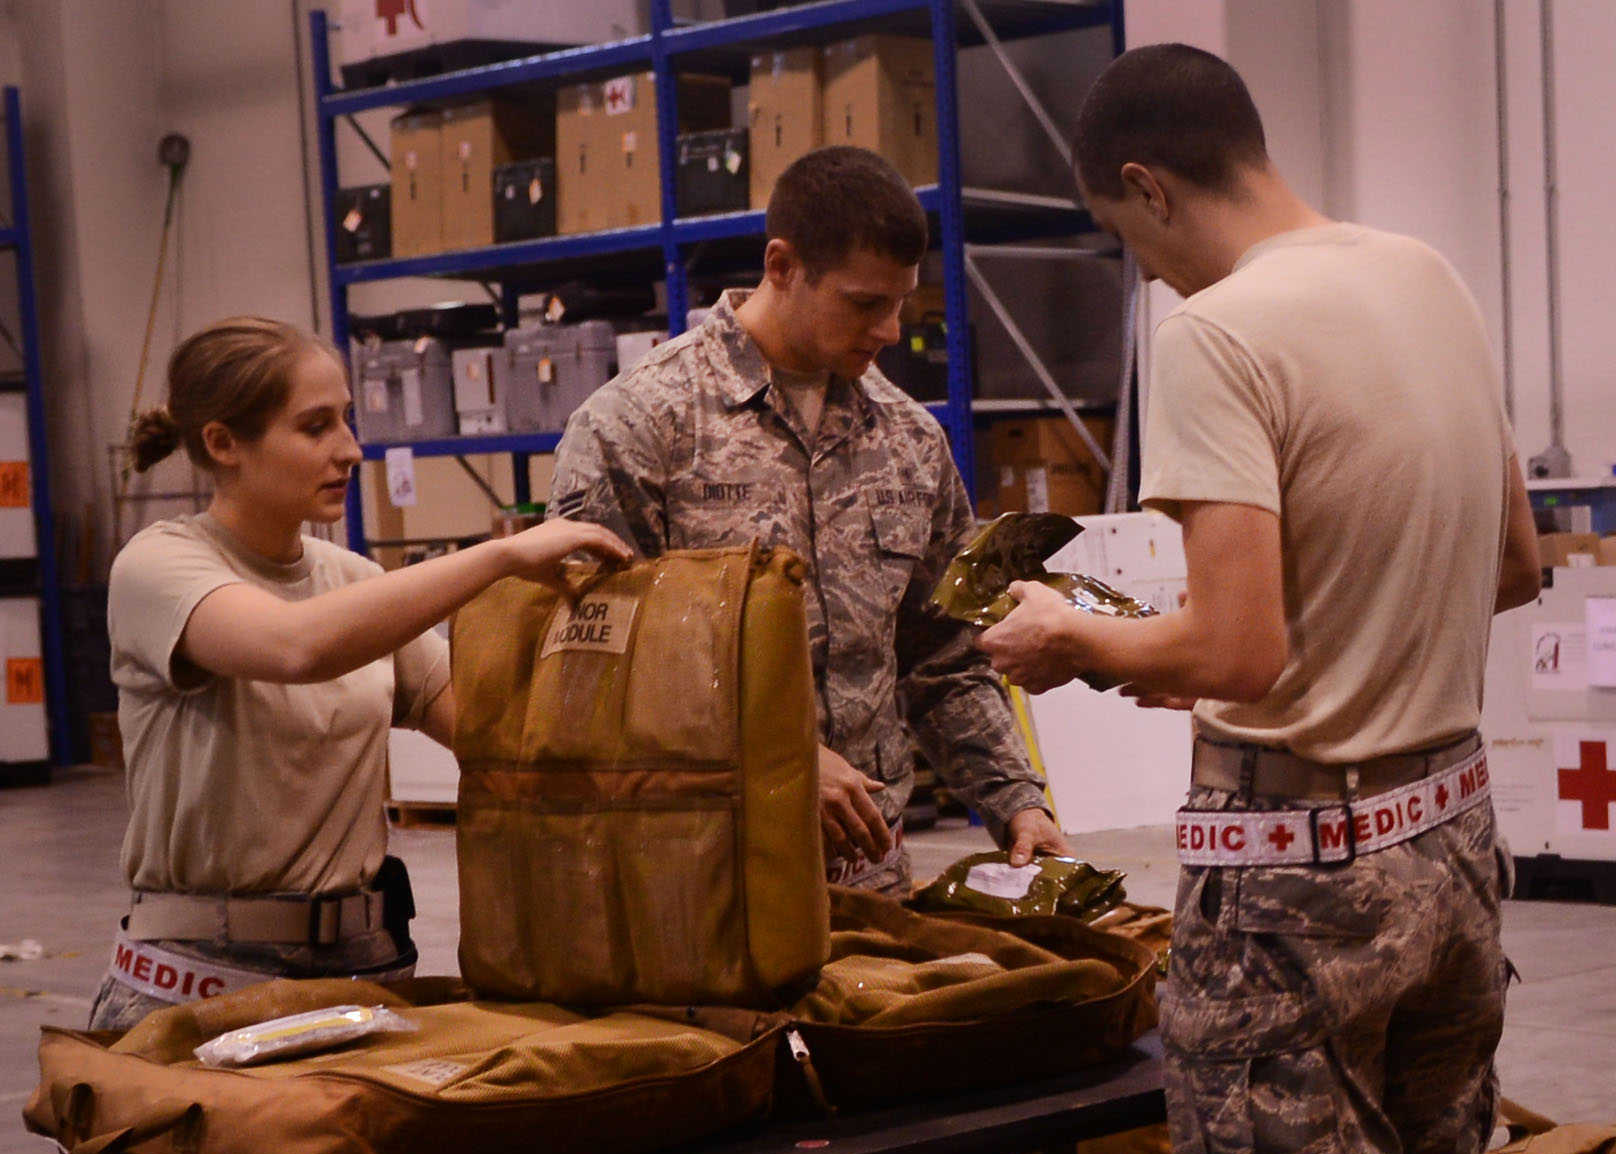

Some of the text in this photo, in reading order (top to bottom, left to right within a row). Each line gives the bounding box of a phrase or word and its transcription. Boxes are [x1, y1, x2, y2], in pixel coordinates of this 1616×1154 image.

[703, 483, 752, 501] DIOTTE
[553, 623, 612, 645] ODULE
[1177, 824, 1246, 852] EDIC
[1320, 795, 1425, 849] MEDIC
[1459, 757, 1489, 800] ME
[114, 943, 225, 999] MEDIC
